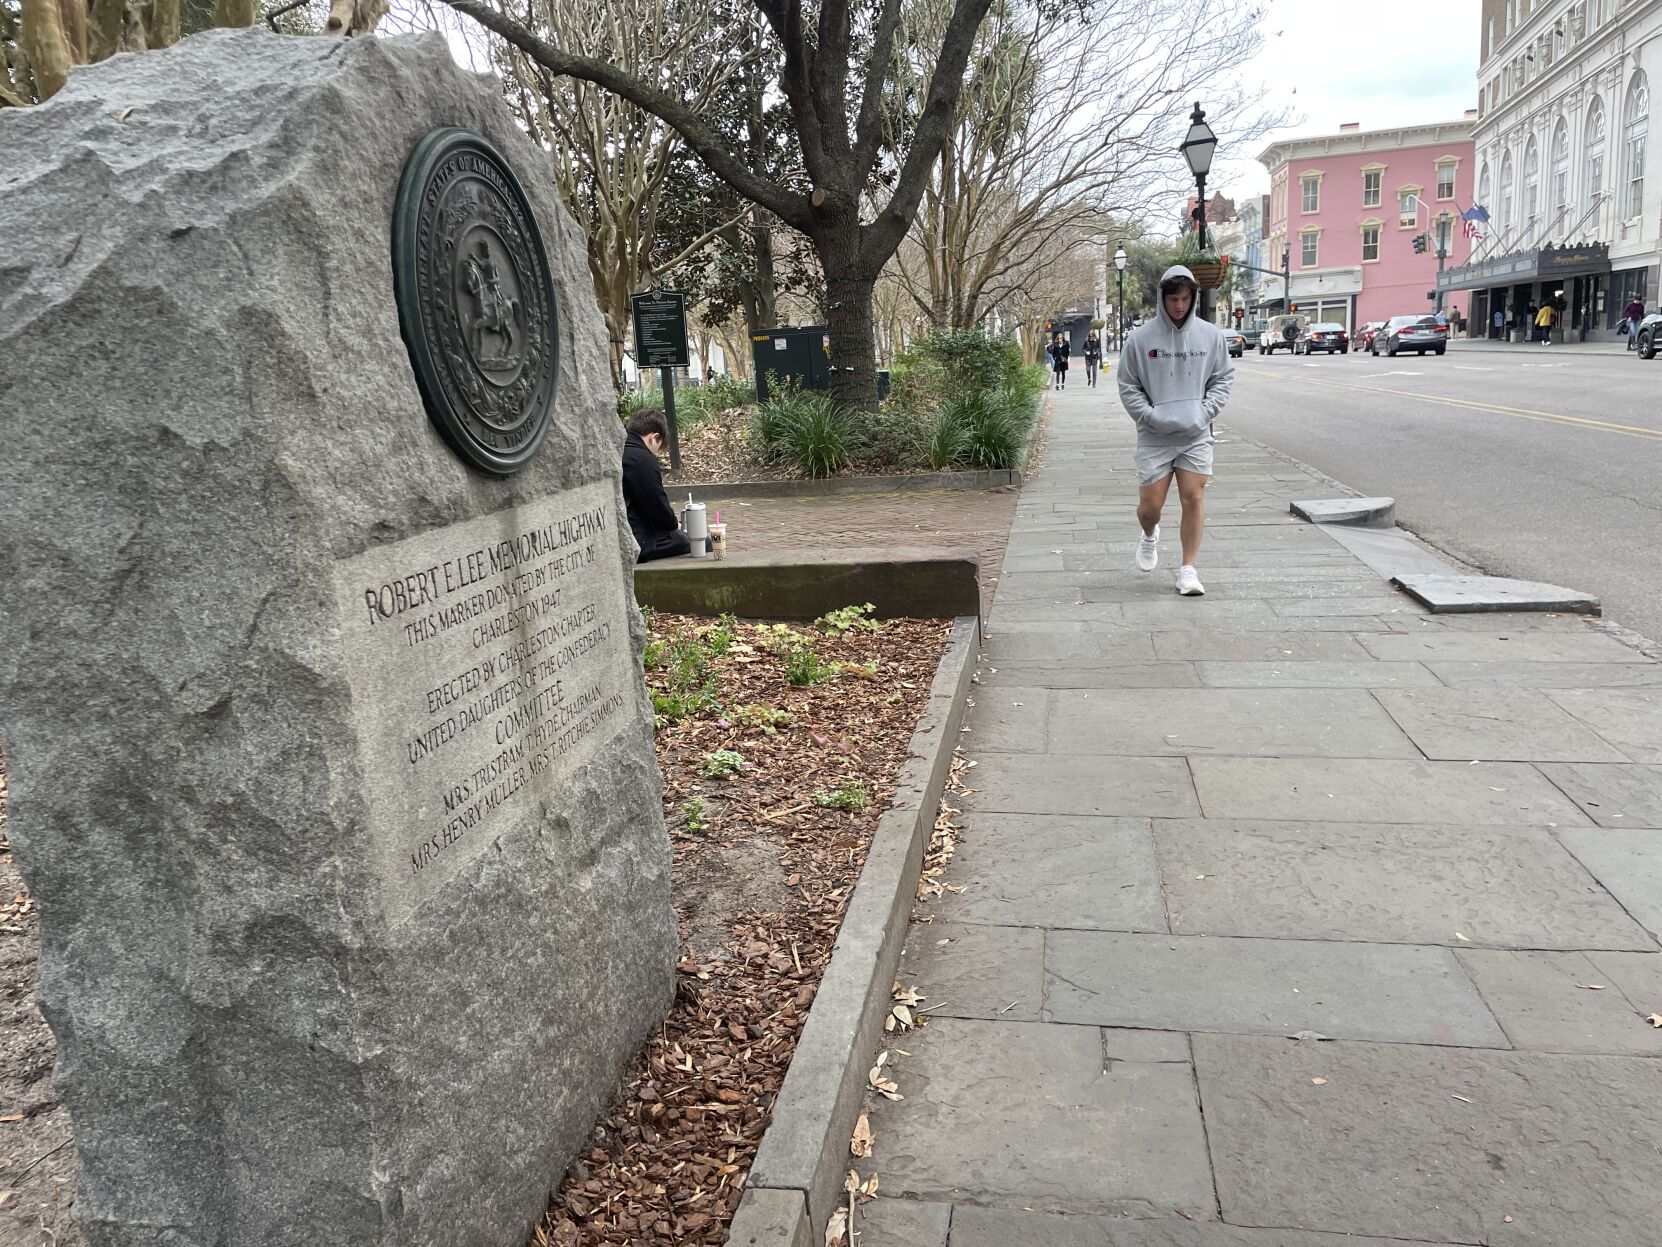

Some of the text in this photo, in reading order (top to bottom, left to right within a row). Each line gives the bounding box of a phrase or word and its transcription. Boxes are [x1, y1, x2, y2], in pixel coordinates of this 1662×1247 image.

[365, 566, 439, 625] ROBERT
[488, 525, 558, 576] MEMORIAL
[558, 506, 606, 547] HIGHWAY
[404, 544, 595, 647] THIS MARKER DONATED BY THE CITY OF
[427, 603, 596, 714] ERECTED BY CHARLESTON CHAPTER
[473, 588, 561, 649] CHARLESTON 1947
[407, 620, 611, 764] UNITED DAUGHTERS OF THE CONFEDERACY
[472, 739, 523, 792] TRISTRAM
[560, 684, 603, 726] CHAIRMAN
[496, 680, 565, 745] COMMITTEE
[558, 716, 590, 755] RITCHIE
